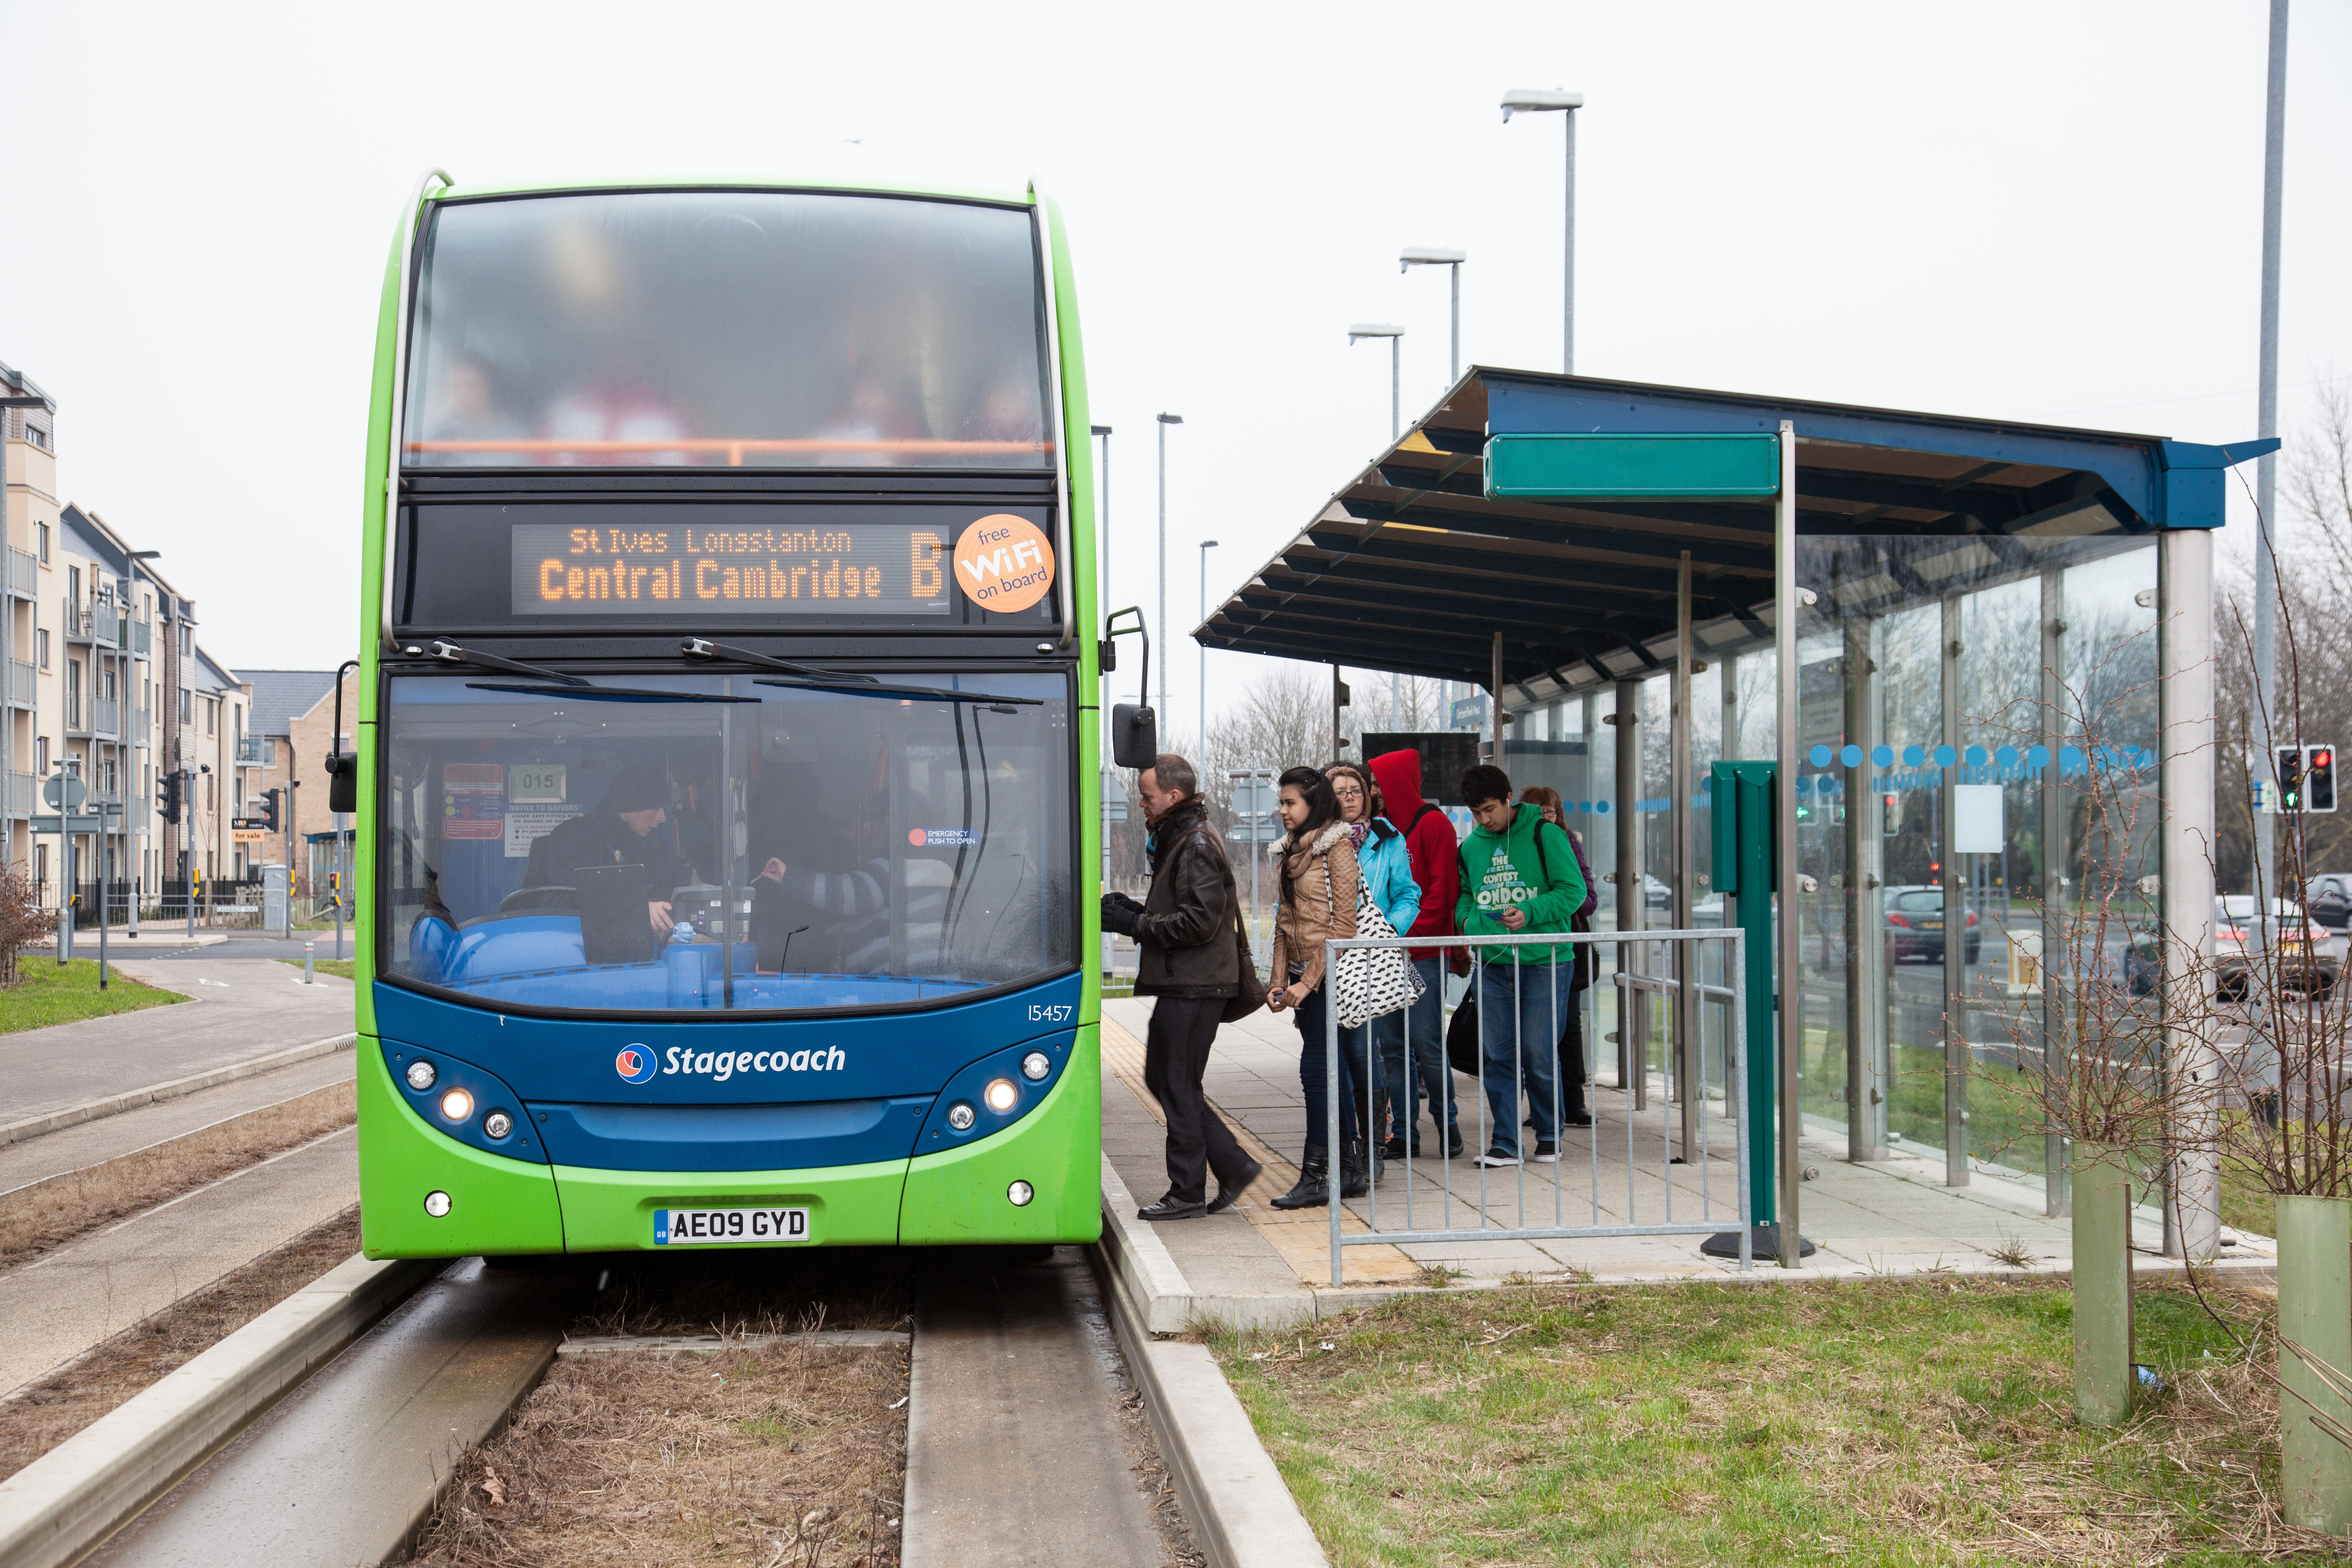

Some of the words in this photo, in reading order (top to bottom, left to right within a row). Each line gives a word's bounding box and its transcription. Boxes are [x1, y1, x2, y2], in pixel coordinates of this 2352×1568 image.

[570, 529, 601, 552] St
[610, 529, 668, 552] Ives
[978, 528, 1010, 545] free
[911, 532, 942, 598] B
[960, 539, 1043, 582] WiFi
[540, 560, 680, 599] Central
[696, 560, 881, 599] Cambridge
[977, 585, 998, 599] on
[1001, 565, 1048, 592] board
[524, 774, 554, 788] 015
[1492, 855, 1509, 866] THE
[1483, 872, 1519, 884] CONTEST
[1474, 887, 1538, 905] ONDON
[1029, 1005, 1072, 1021] 15457
[663, 1045, 845, 1081] Stagecoach
[753, 1211, 805, 1236] GYD
